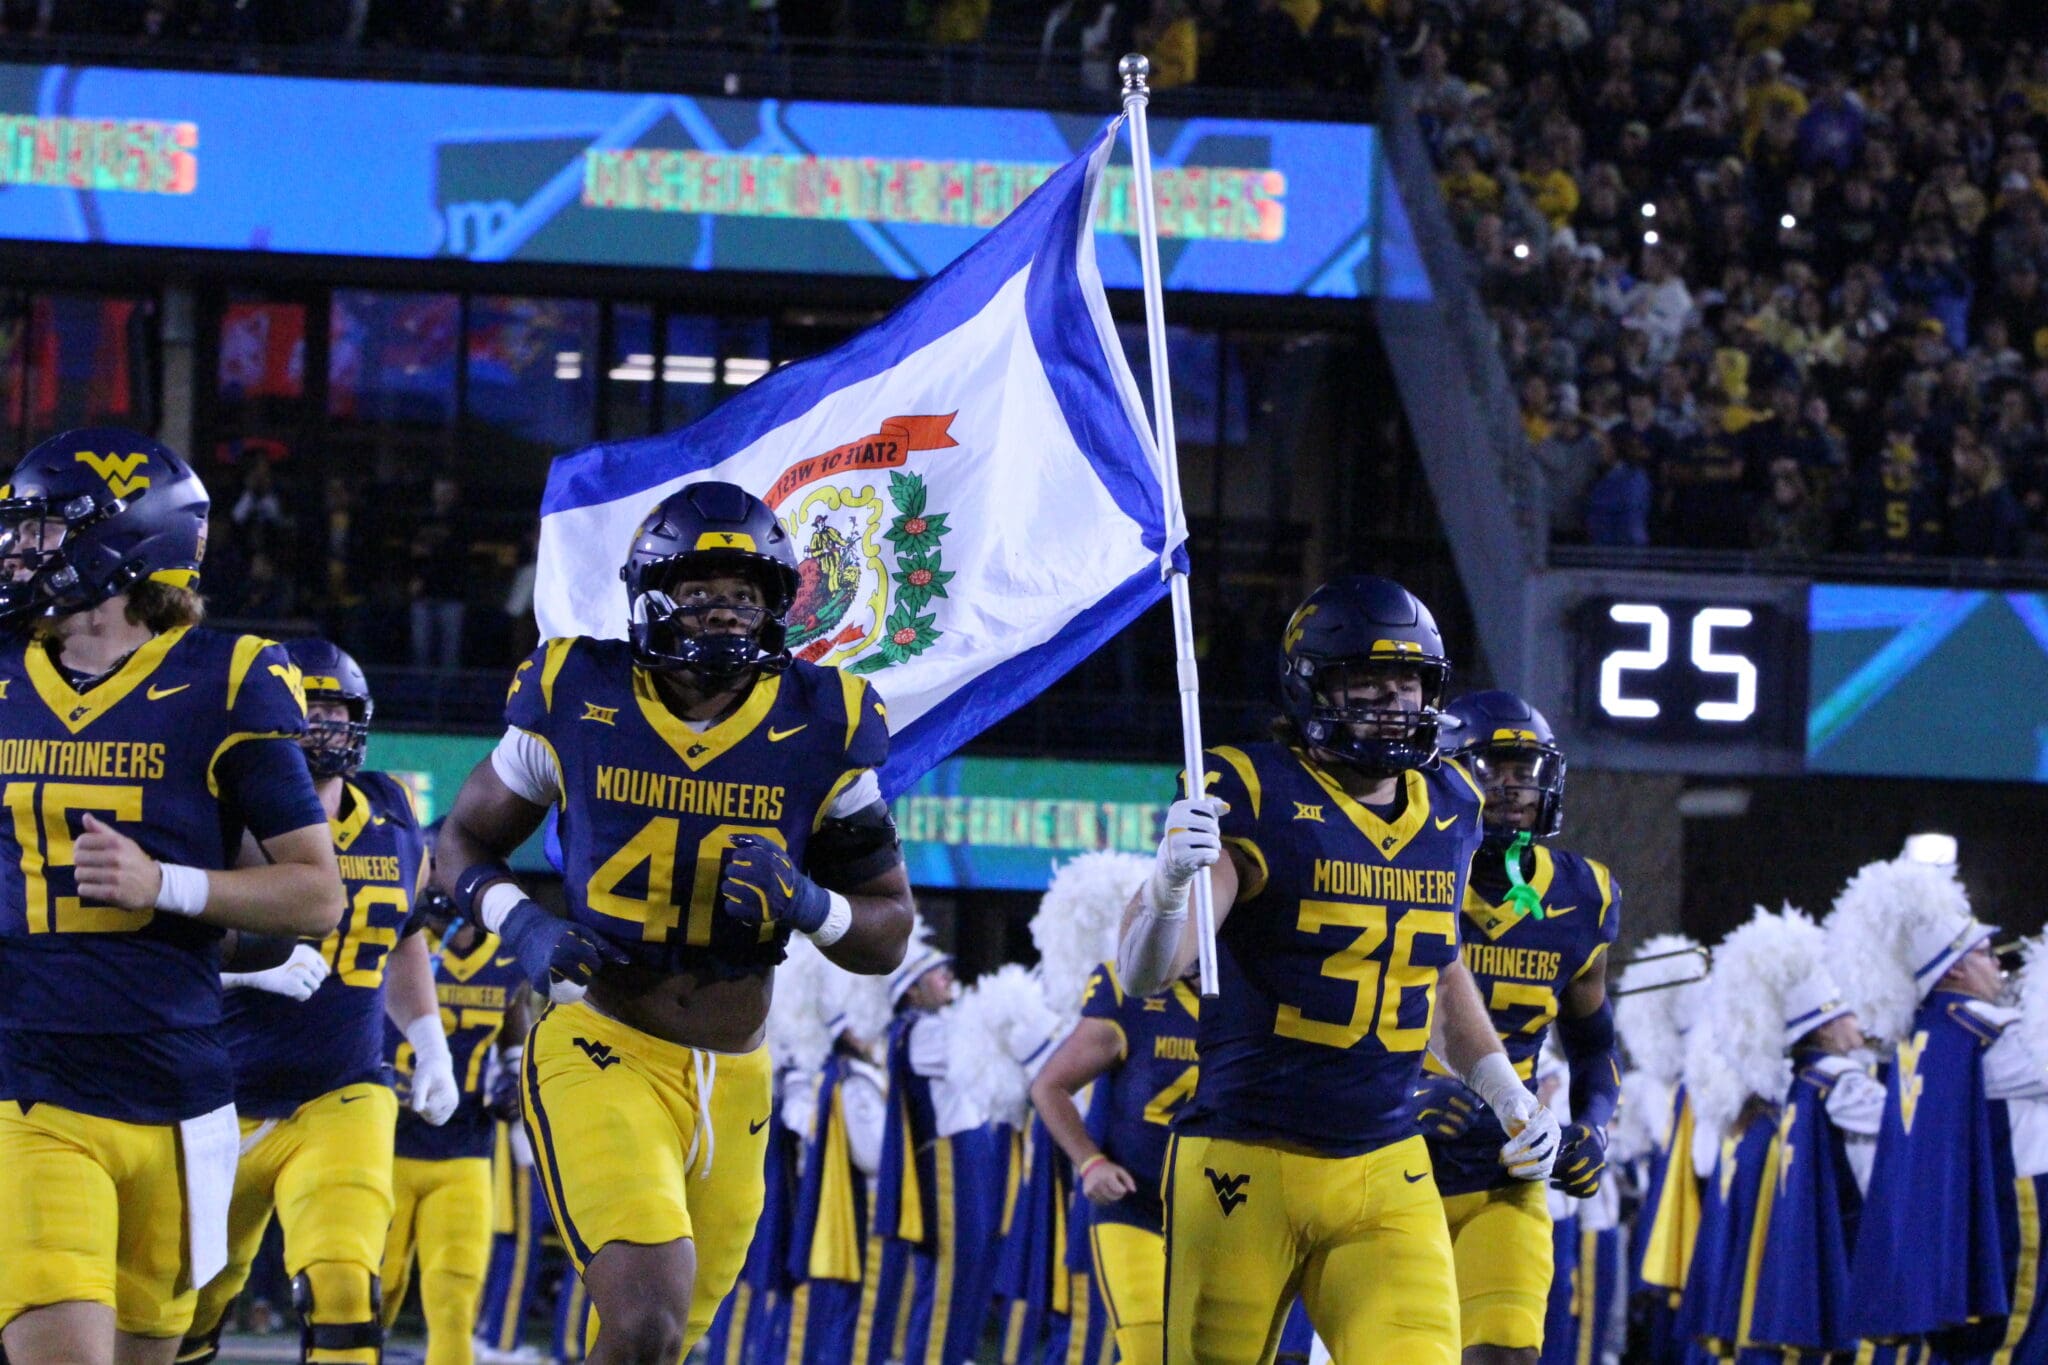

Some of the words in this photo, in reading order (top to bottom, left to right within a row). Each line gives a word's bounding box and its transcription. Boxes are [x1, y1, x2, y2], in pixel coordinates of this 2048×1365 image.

[1600, 604, 1757, 722] 25
[596, 764, 785, 821] MOUNTAINEERS
[3, 782, 154, 934] 15
[336, 855, 400, 881] AINEERS
[1313, 858, 1455, 904] MOUNTAINEERS
[1273, 899, 1456, 1053] 36
